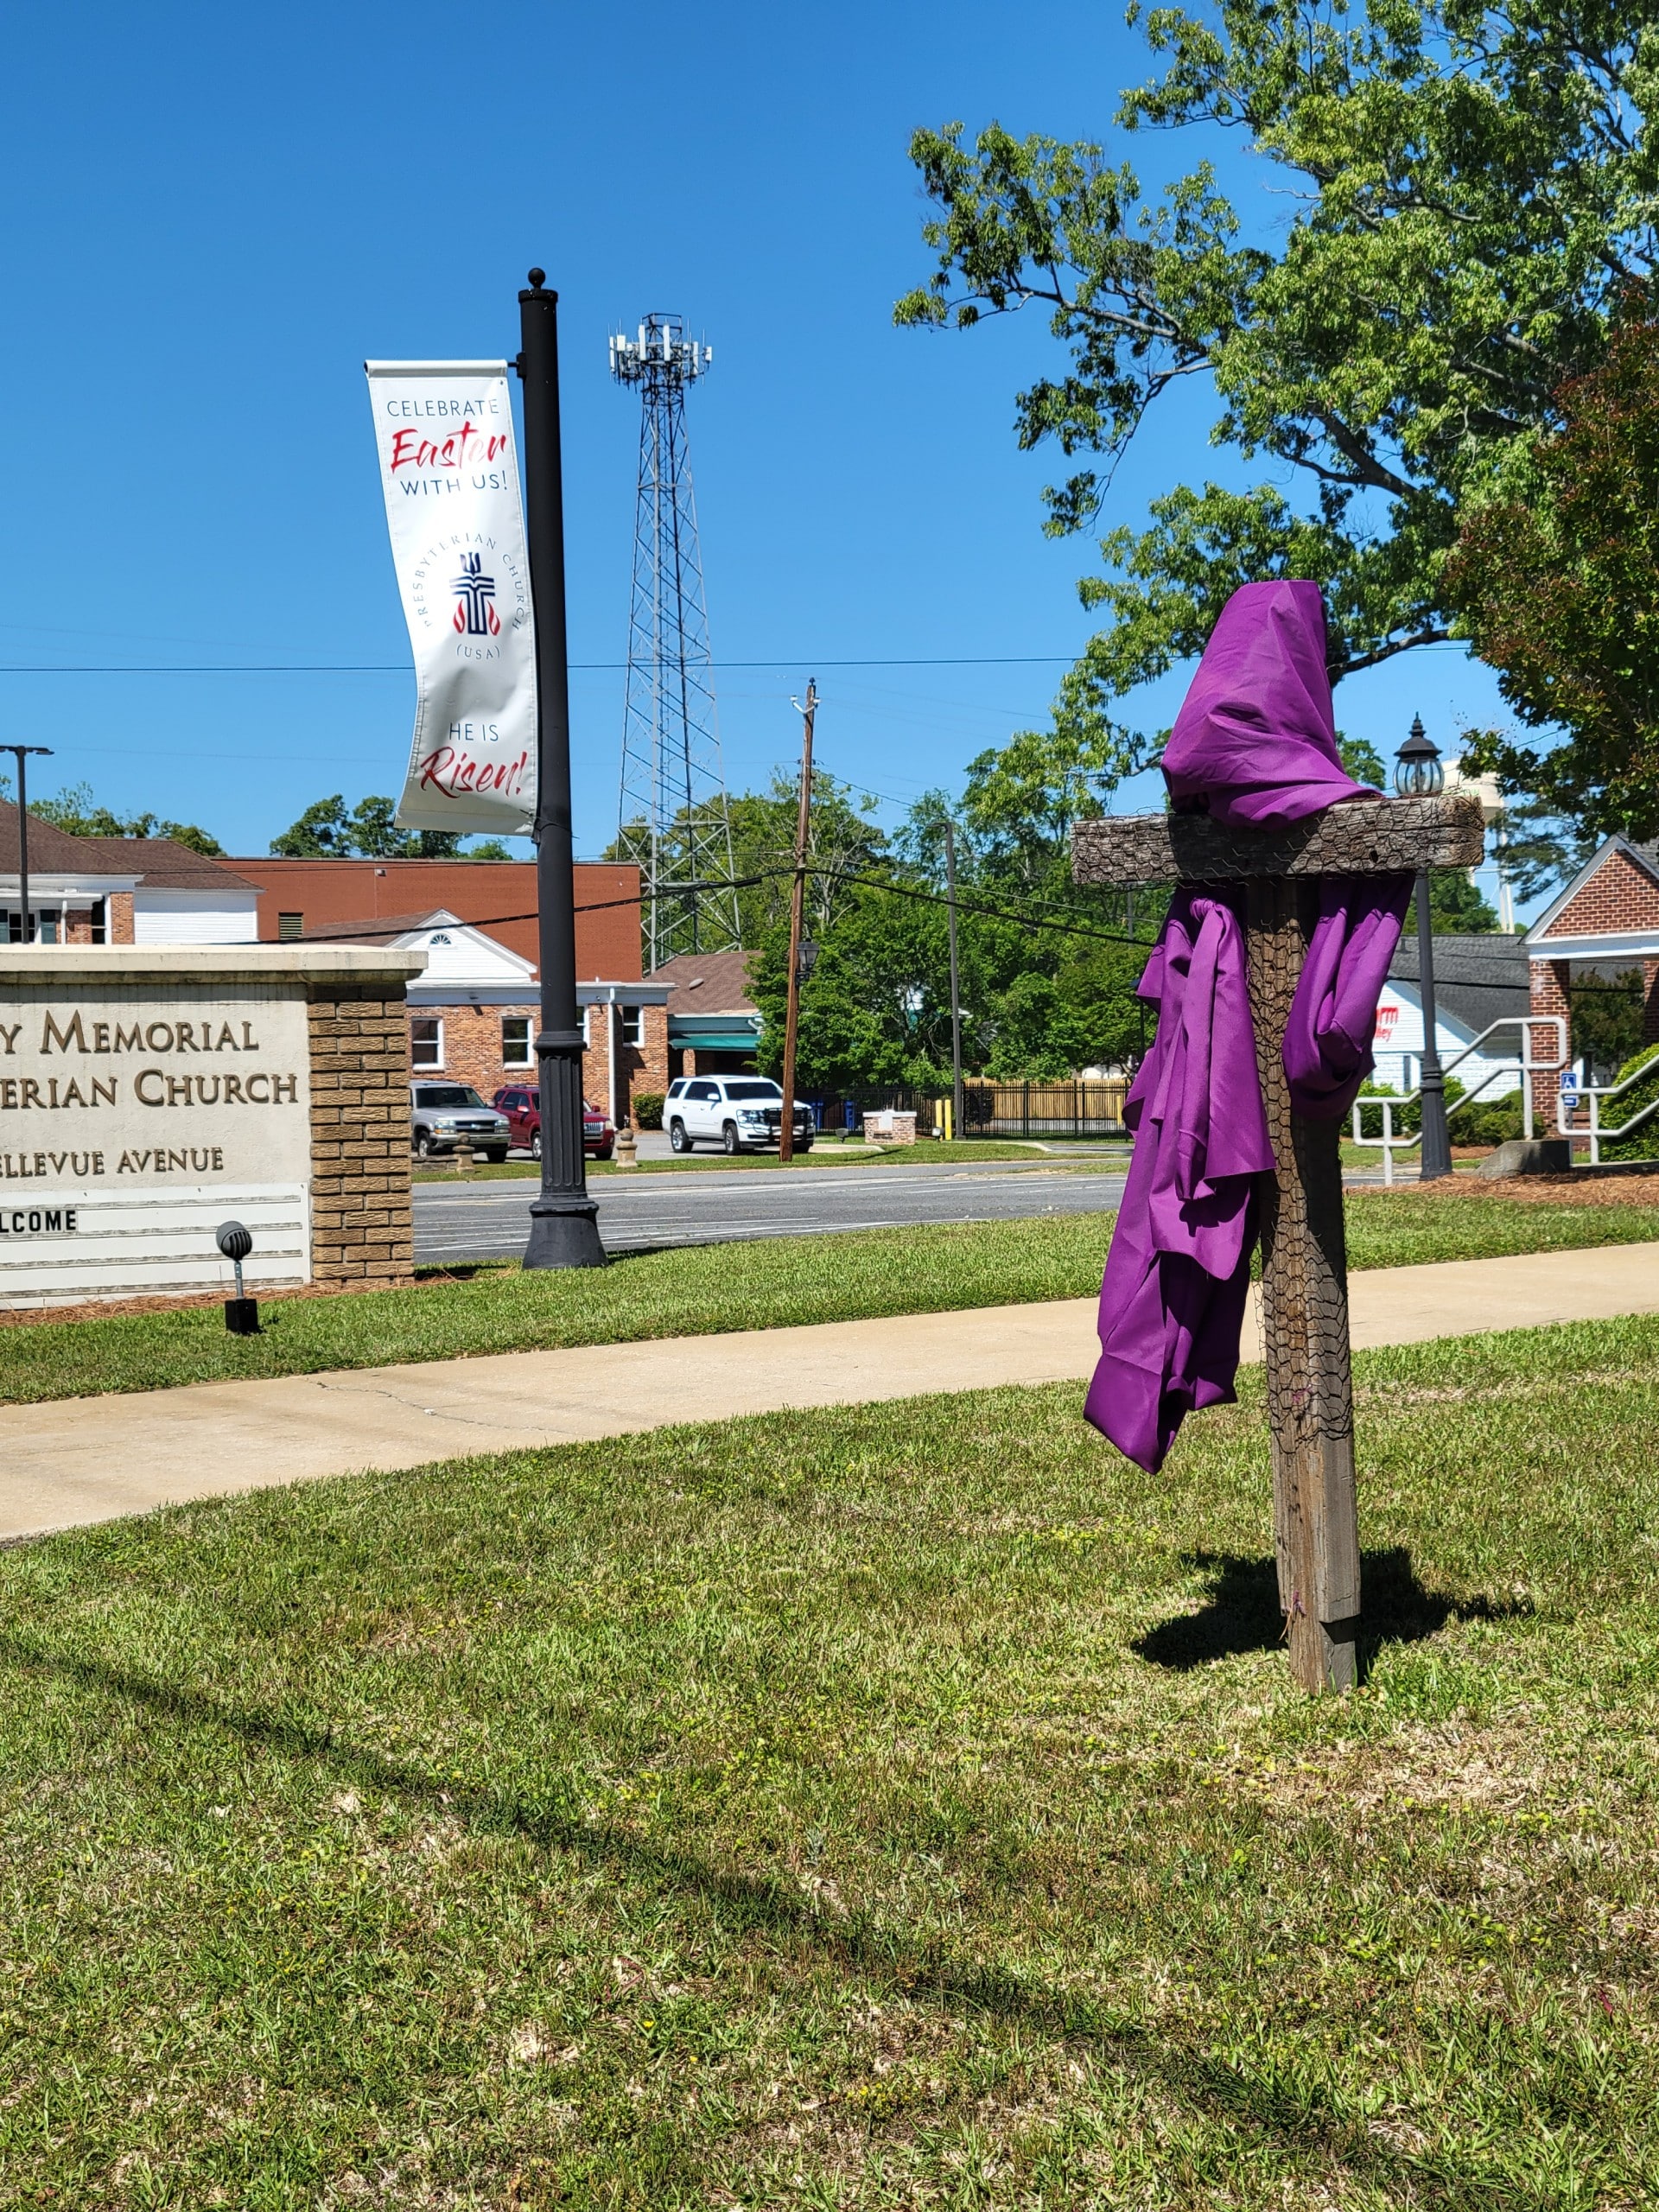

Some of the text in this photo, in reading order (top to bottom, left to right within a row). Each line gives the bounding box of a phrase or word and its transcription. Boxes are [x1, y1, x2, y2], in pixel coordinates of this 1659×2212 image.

[386, 399, 499, 417] CELEBRATE
[390, 421, 507, 474] Easter
[400, 470, 508, 496] WITH US!
[412, 532, 525, 631] PRESBYTERIAN CHURCH
[456, 643, 500, 660] (USA)
[448, 722, 499, 742] HE IS
[420, 746, 528, 799] Risen!
[39, 1009, 259, 1054] MEMORIAL
[134, 1069, 299, 1107] CHURCH
[0, 1147, 224, 1179] LLEVUE AVENUE
